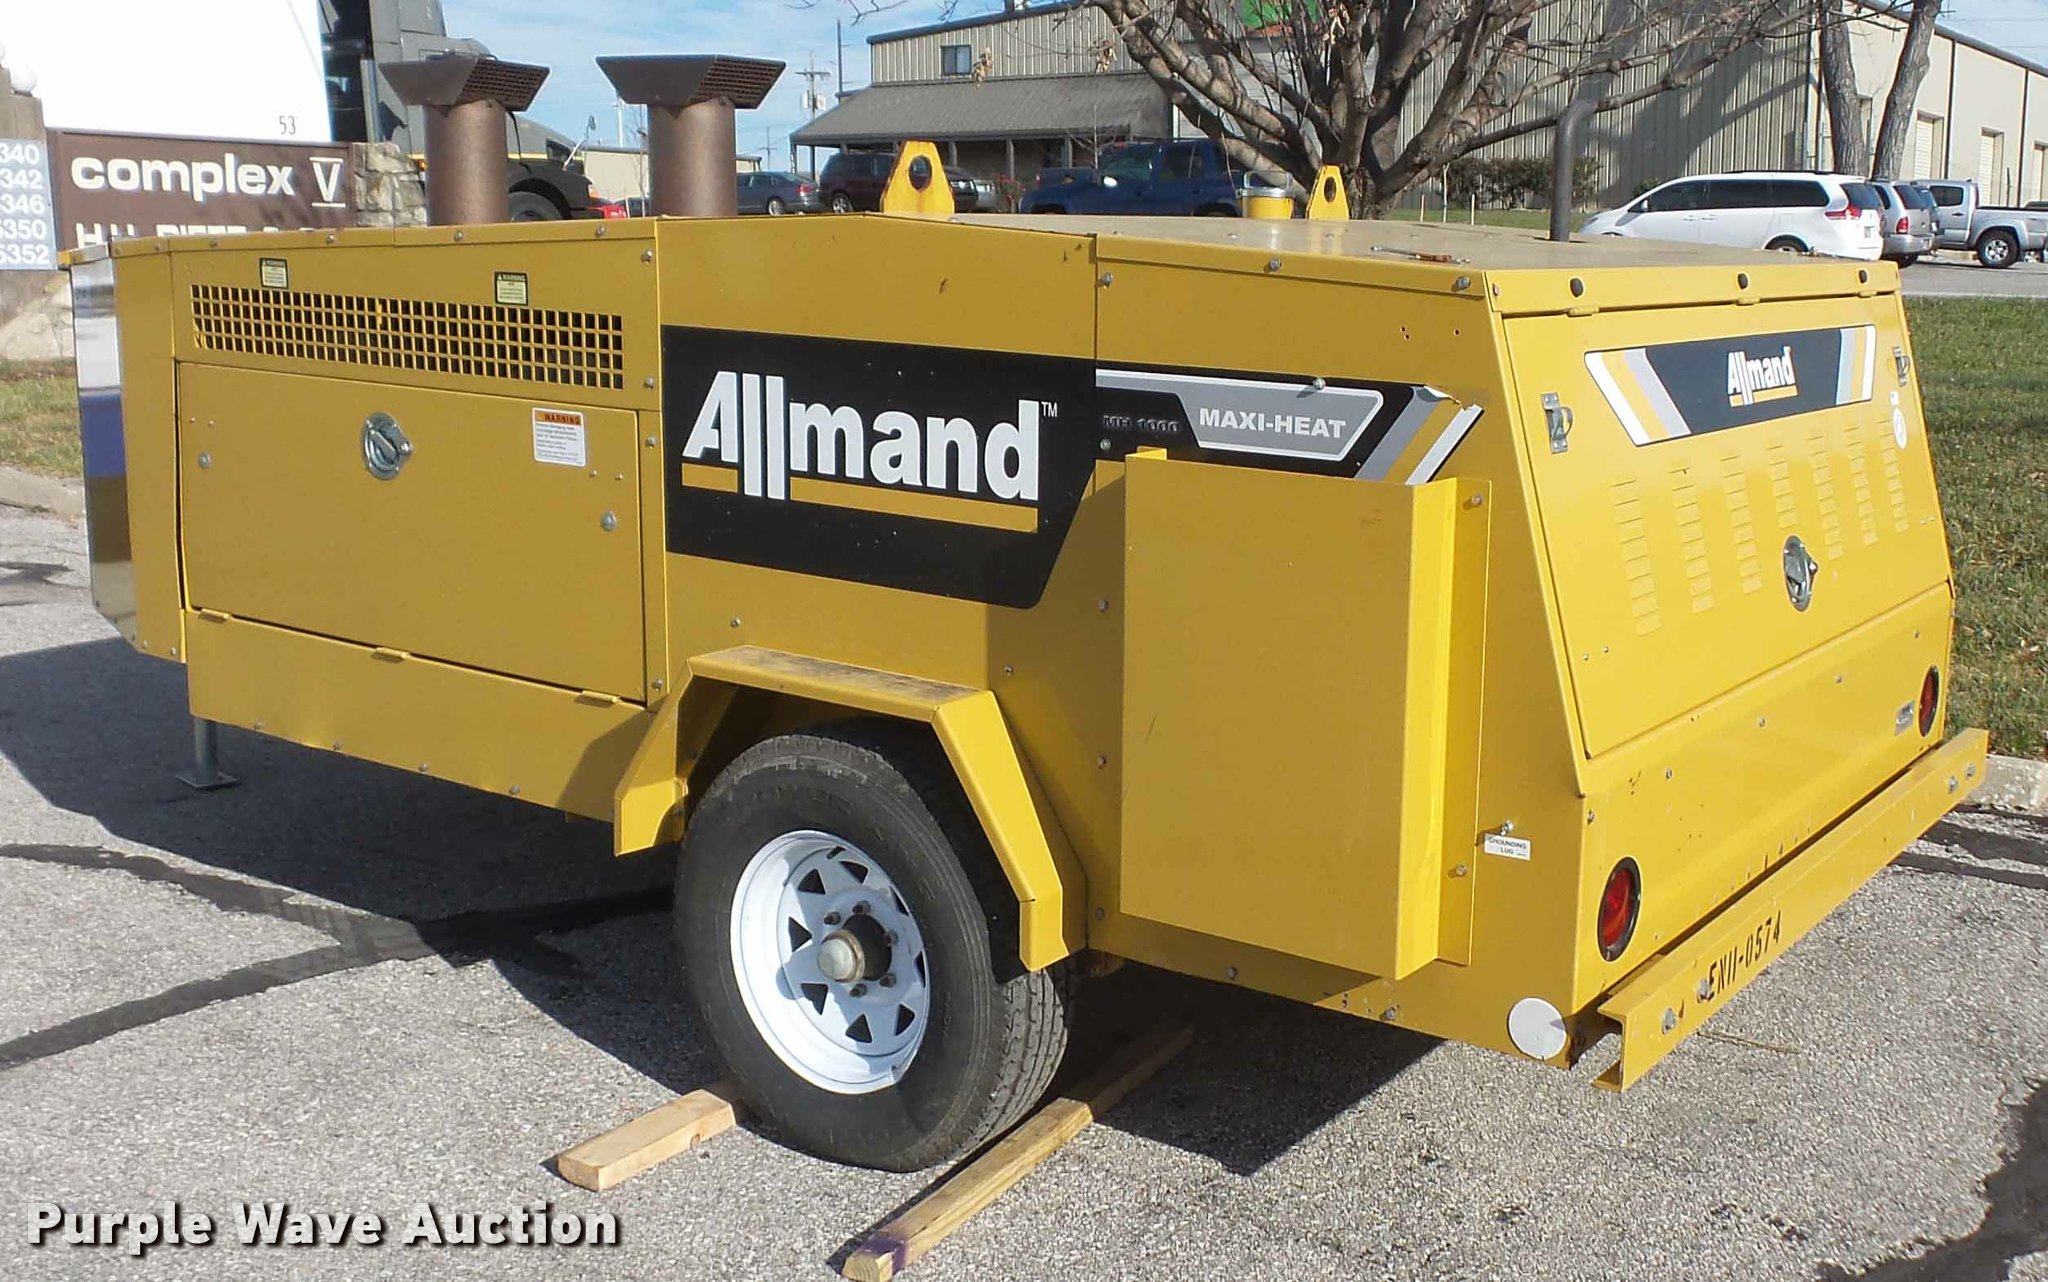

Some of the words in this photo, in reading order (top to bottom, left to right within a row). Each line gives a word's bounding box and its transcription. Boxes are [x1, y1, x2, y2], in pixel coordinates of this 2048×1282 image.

[279, 115, 296, 135] 53
[0, 168, 43, 189] 342
[70, 153, 295, 202] complex
[309, 157, 346, 208] V
[0, 193, 45, 215] 346
[1727, 345, 1797, 406] Allmand
[544, 413, 581, 425] WARNING
[1200, 408, 1346, 439] MAXI-HEAT
[682, 371, 1039, 501] Allmand
